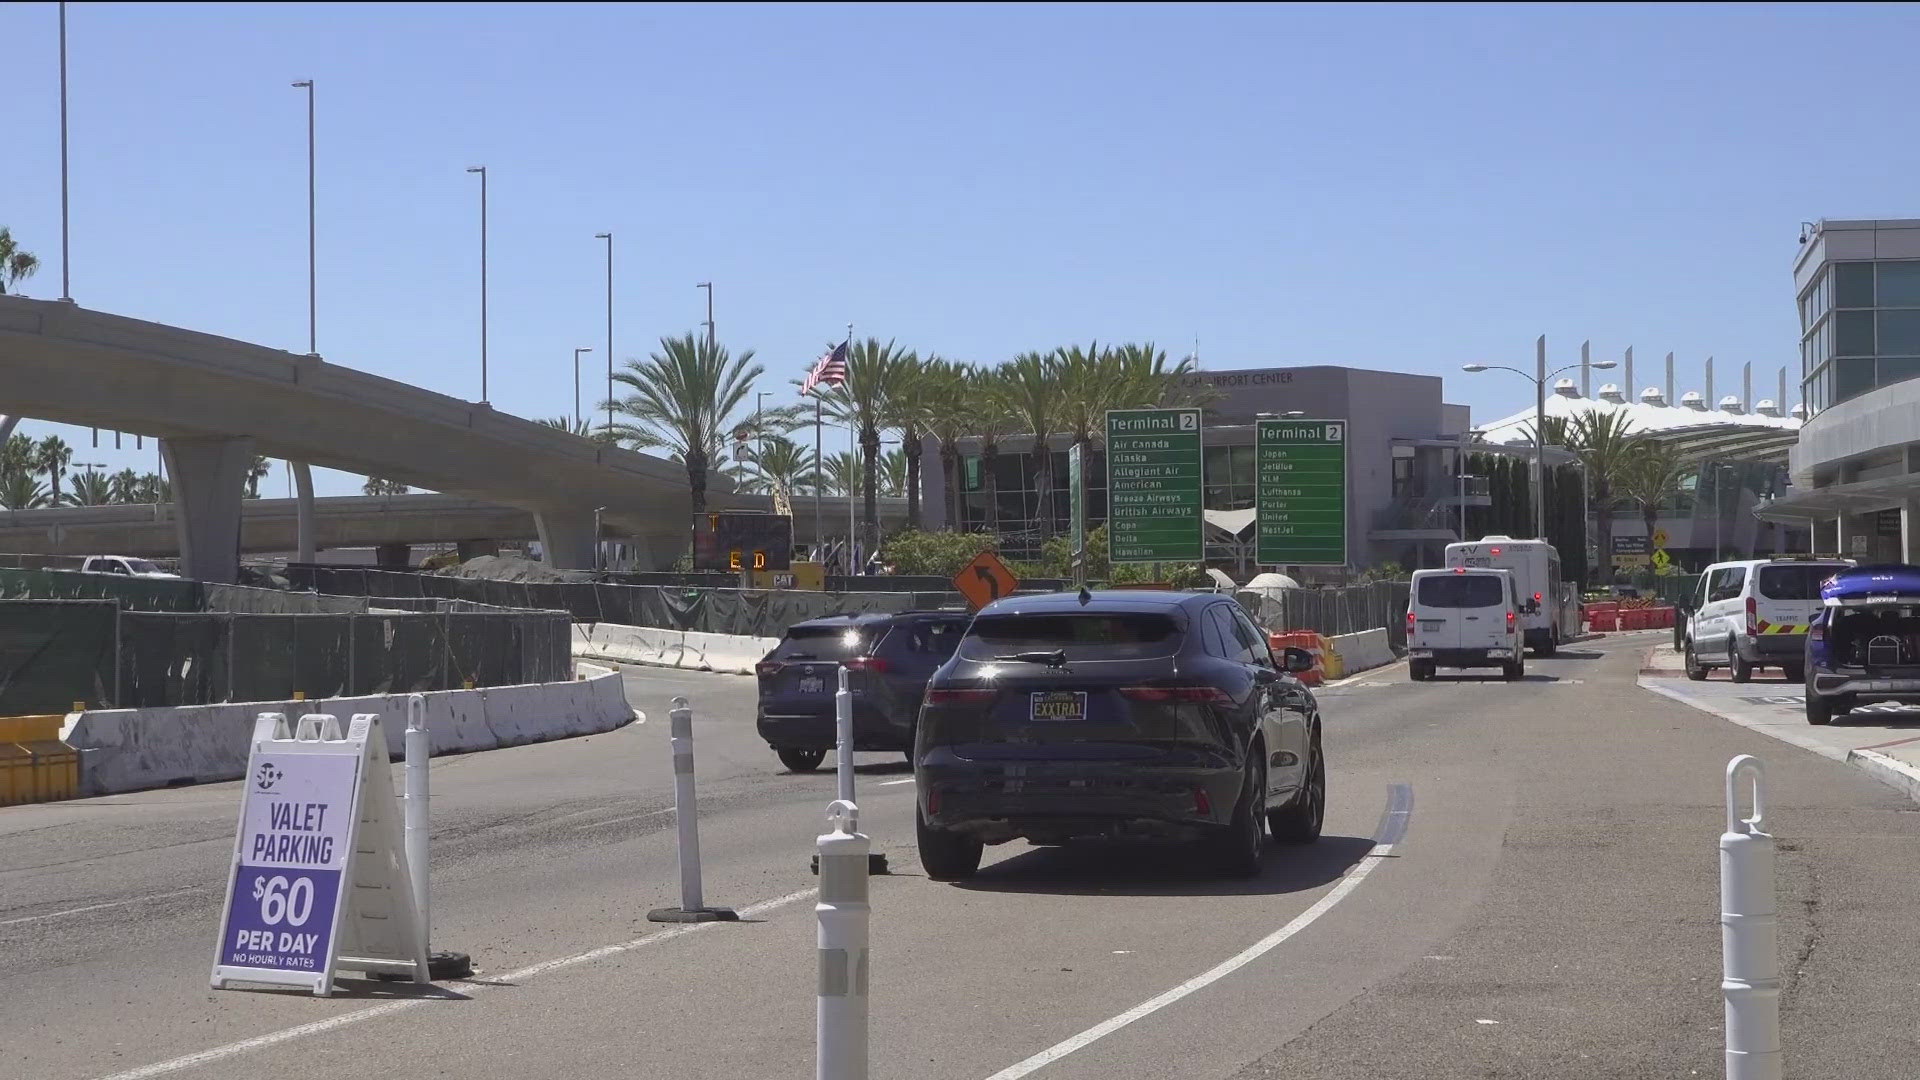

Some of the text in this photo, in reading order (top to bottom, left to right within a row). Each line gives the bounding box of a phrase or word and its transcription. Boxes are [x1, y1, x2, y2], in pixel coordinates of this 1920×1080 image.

[1252, 372, 1293, 385] CENTER
[1110, 415, 1193, 430] Terminal 2
[1260, 427, 1339, 439] Terminal 2
[1113, 440, 1170, 449] Air Canada
[1113, 453, 1148, 463] Alaska
[1262, 450, 1287, 459] Japan
[1114, 467, 1179, 477] Allegiant Air
[1262, 463, 1293, 471] JetBlue
[1262, 475, 1280, 483] KLM
[1114, 480, 1162, 490] American
[1262, 488, 1302, 496] Lufthansa
[1114, 494, 1182, 504] Breeze Airways
[1262, 500, 1287, 509] Porter
[1114, 506, 1192, 516] British Airways
[1262, 513, 1288, 521] United
[1115, 521, 1137, 531] Copa
[1262, 526, 1294, 534] WestJet
[1115, 535, 1138, 543] Delta
[1115, 548, 1154, 556] Hawaiian
[773, 575, 794, 587] CAT
[1034, 702, 1082, 716] EXXTRA1
[270, 802, 327, 832] VALET
[252, 833, 334, 865] PARKING
[252, 875, 315, 927] $60
[236, 929, 319, 954] PER DAY
[232, 953, 315, 968] NO HOURLY RATES
